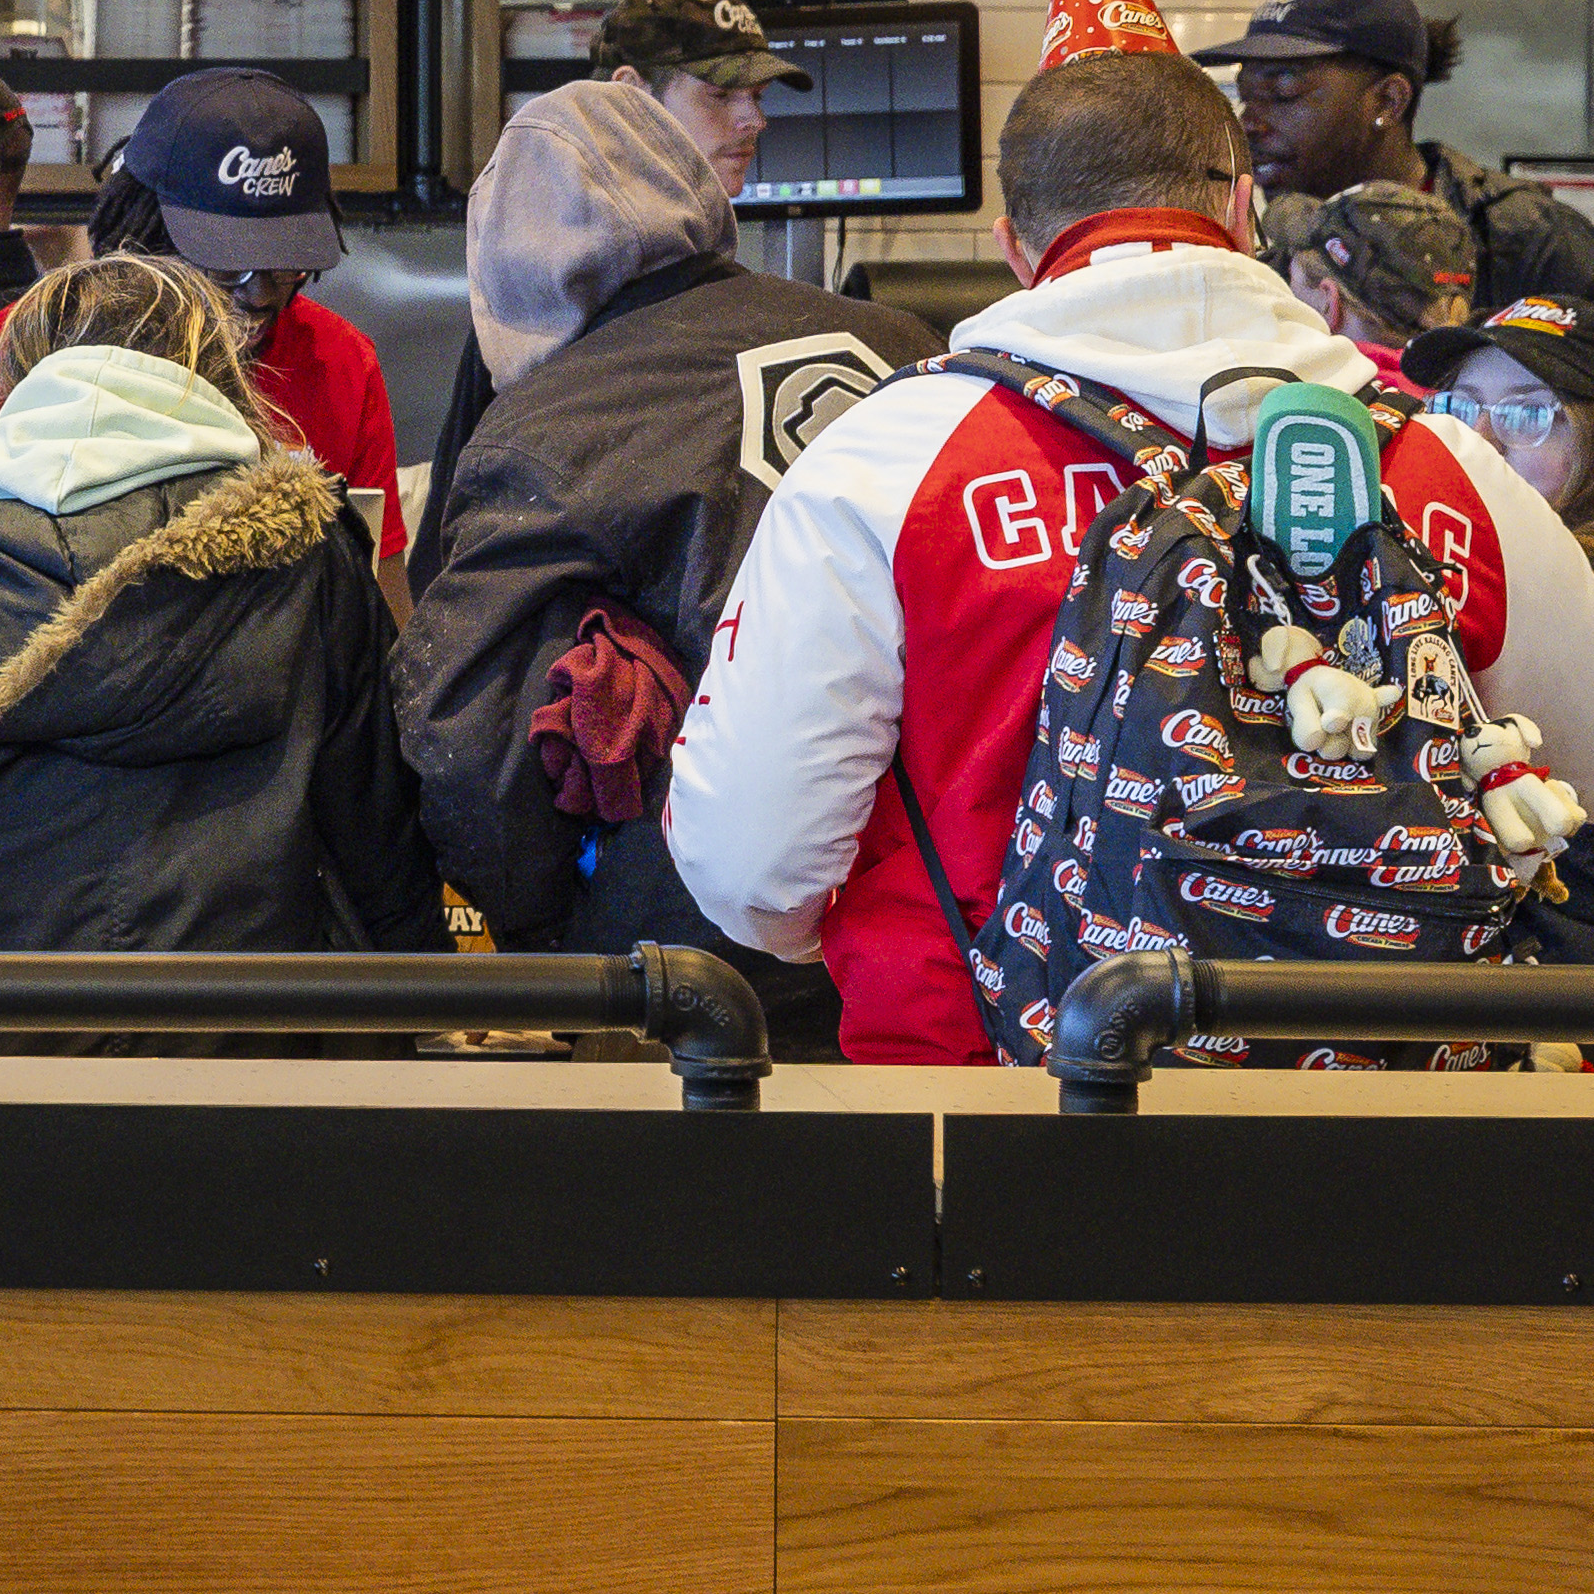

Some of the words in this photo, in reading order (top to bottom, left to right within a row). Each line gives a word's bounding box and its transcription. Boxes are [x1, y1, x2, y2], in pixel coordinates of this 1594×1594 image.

[1101, 3, 1164, 28] Cane's
[218, 146, 297, 184] Cane's
[242, 173, 296, 197] CREW
[1290, 442, 1335, 518] ONE
[1285, 752, 1374, 780] Cane's
